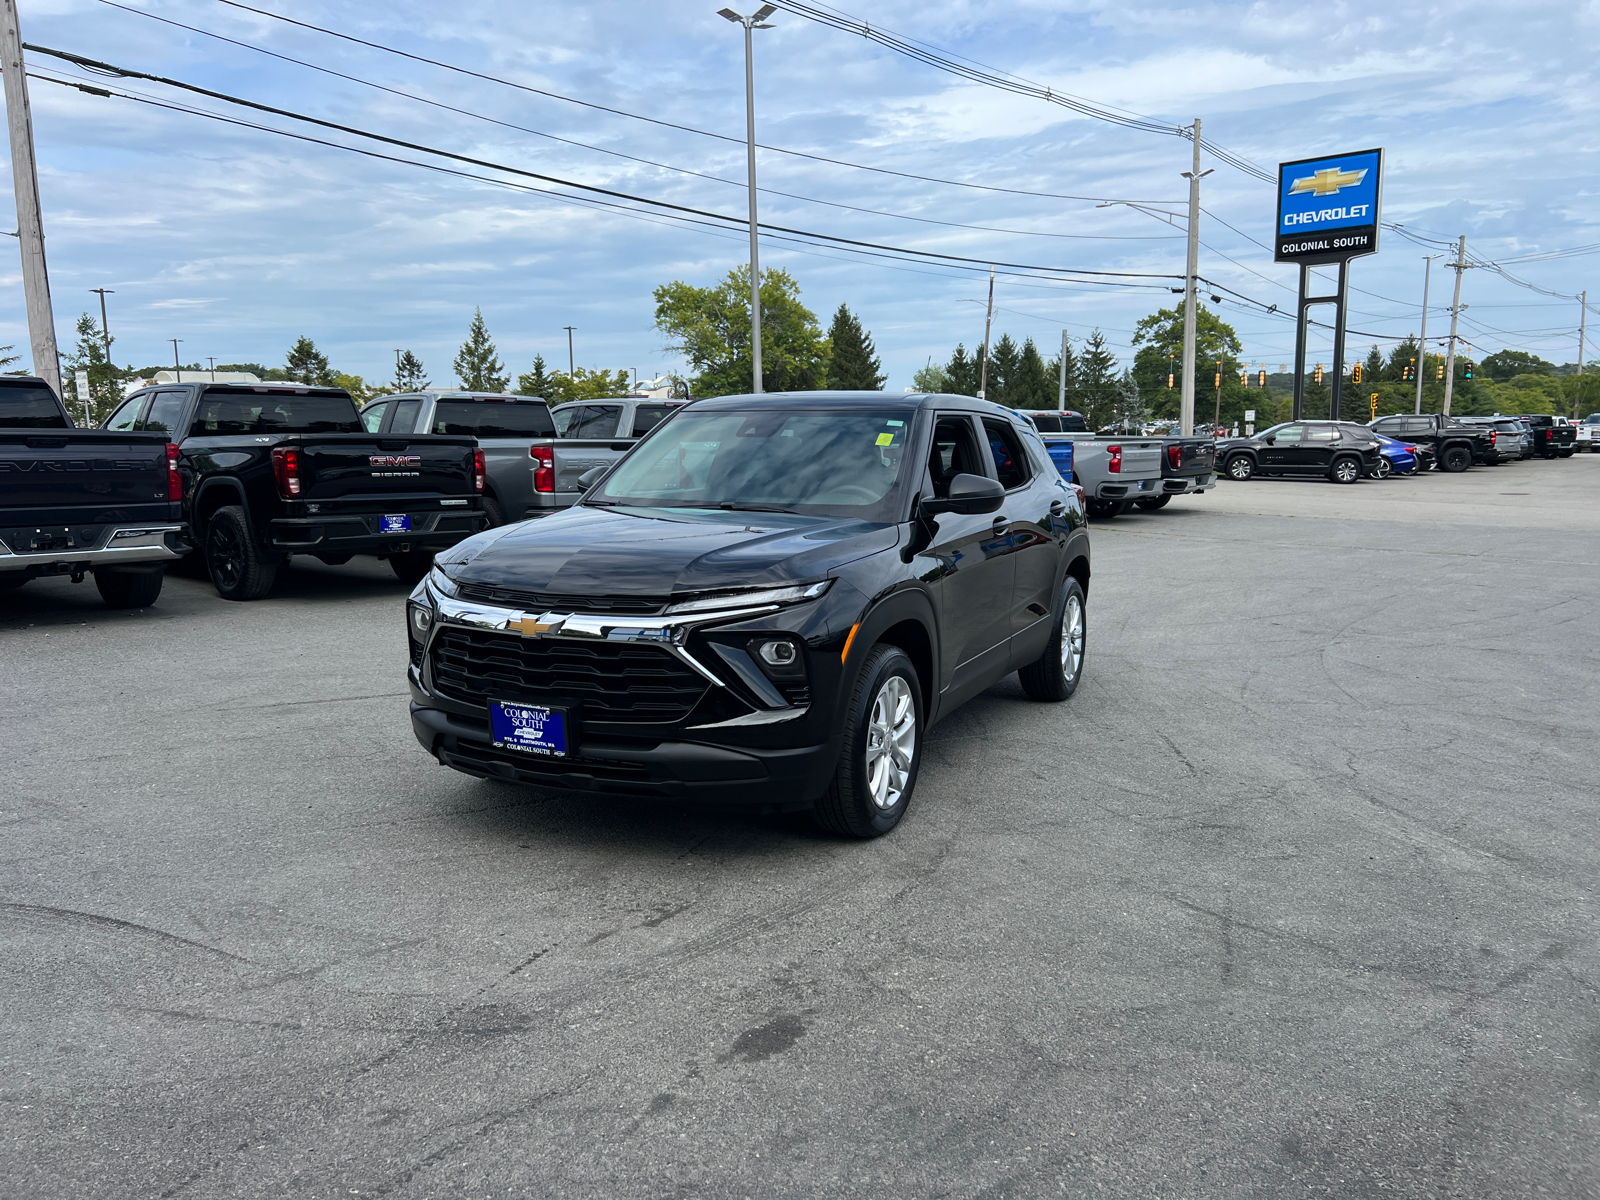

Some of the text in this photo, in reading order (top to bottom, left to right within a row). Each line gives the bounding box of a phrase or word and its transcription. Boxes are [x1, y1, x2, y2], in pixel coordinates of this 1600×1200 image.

[1284, 204, 1369, 226] CHEVROLET
[1281, 236, 1368, 253] COLONIAL SOUTH
[369, 455, 421, 467] GMC
[504, 708, 550, 722] COLONIAL
[512, 718, 543, 729] SOUTH
[516, 729, 540, 737] CHEVROLET
[507, 744, 533, 752] COLONIAL
